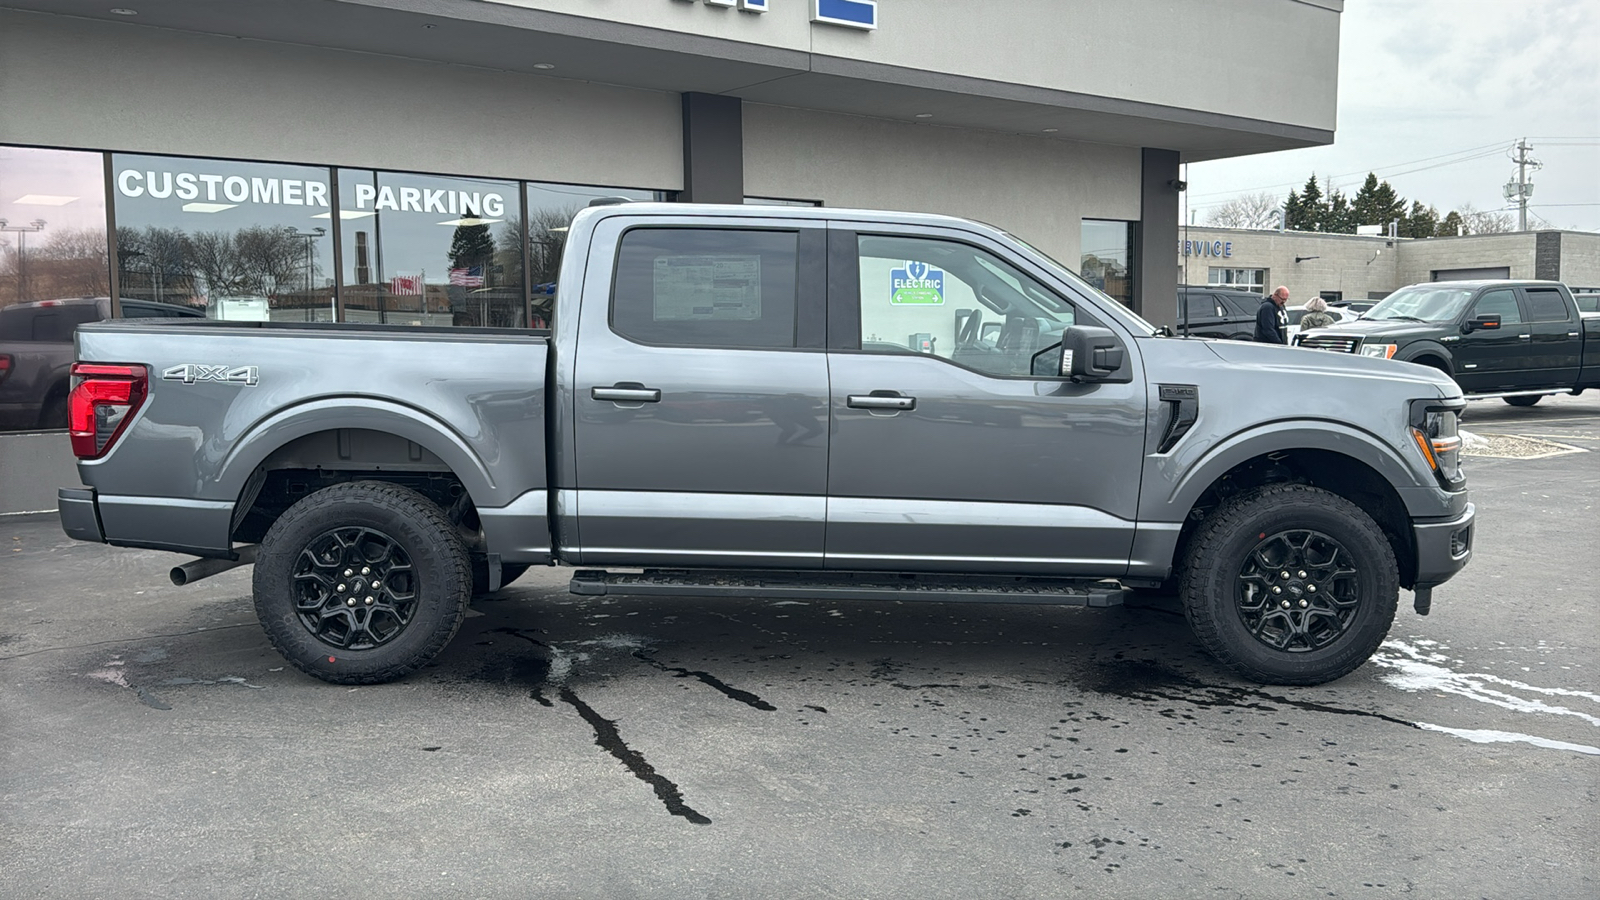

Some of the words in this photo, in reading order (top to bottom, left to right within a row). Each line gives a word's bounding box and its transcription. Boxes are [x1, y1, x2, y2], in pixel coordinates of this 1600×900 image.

[118, 169, 329, 207] CUSTOMER
[355, 184, 504, 217] PARKING
[894, 278, 941, 289] ELECTRIC
